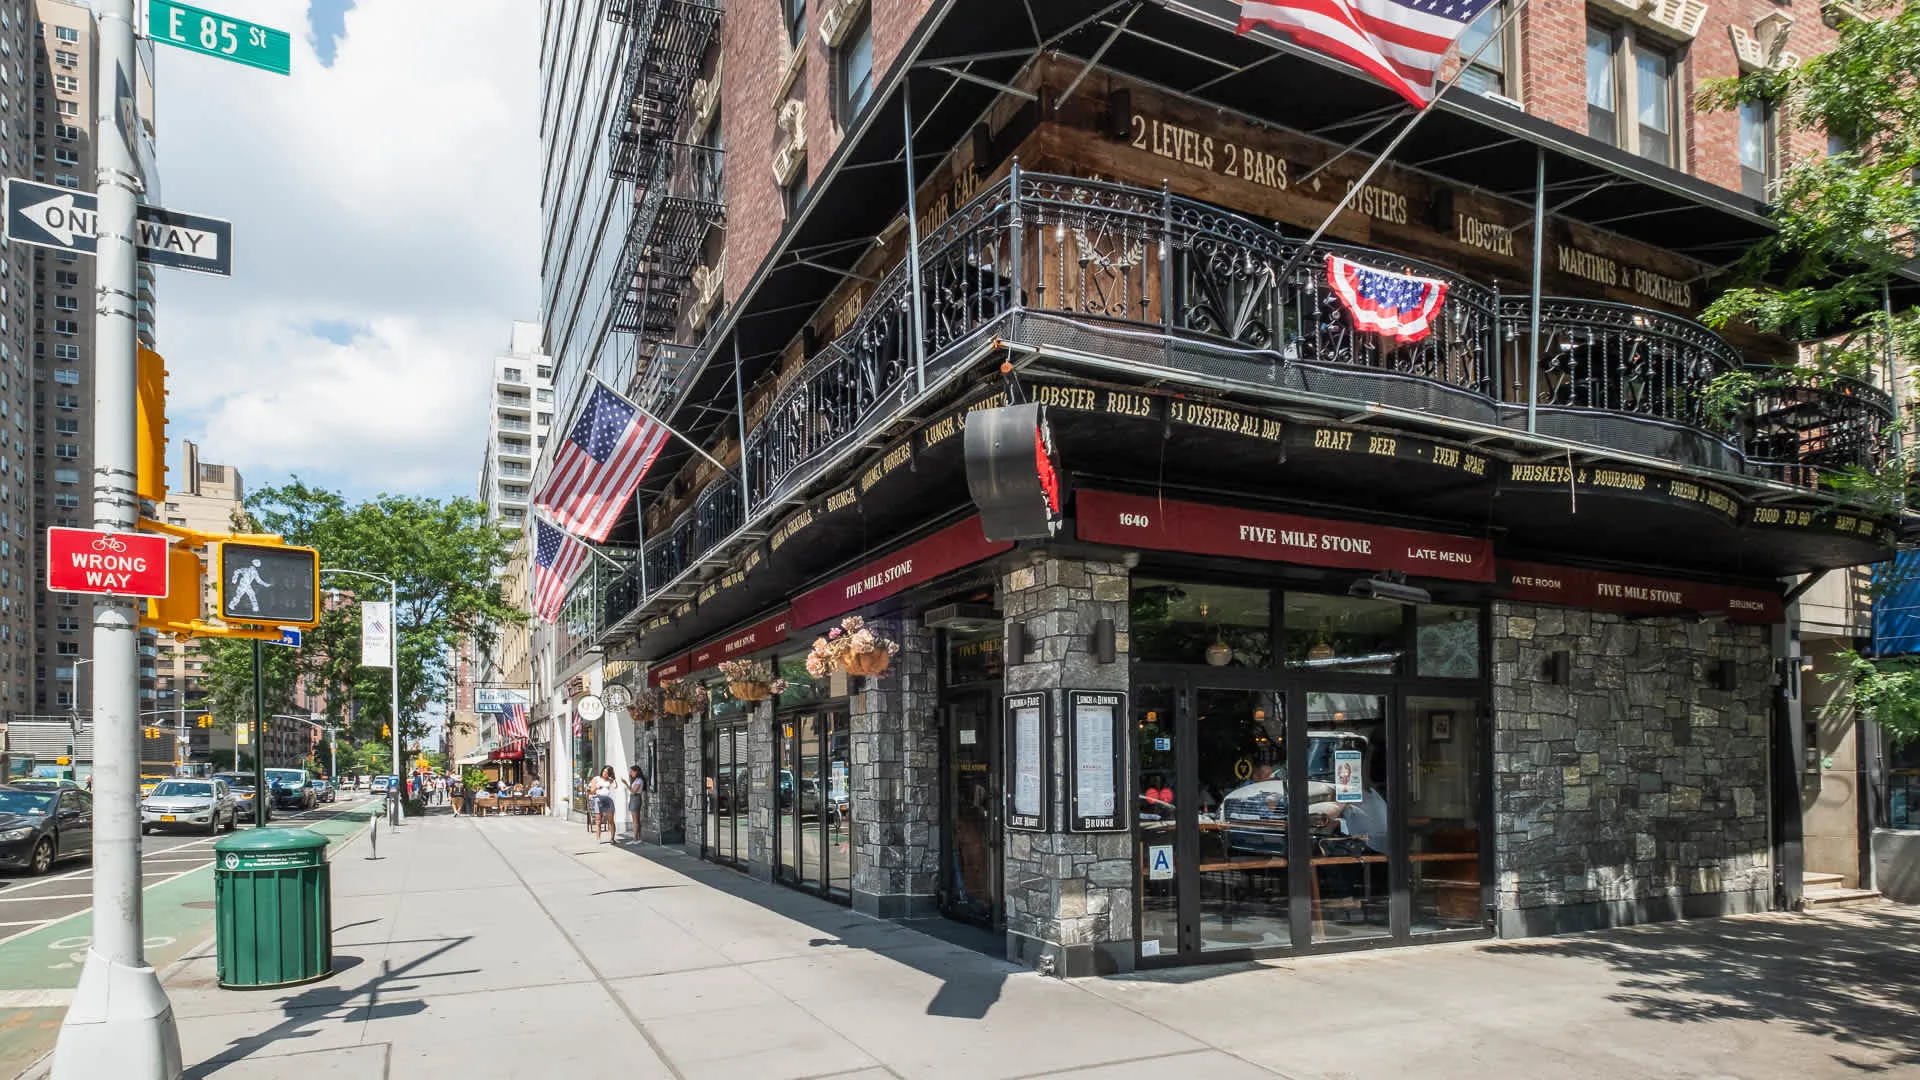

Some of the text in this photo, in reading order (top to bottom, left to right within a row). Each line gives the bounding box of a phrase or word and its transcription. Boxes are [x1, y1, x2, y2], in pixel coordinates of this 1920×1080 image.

[169, 8, 267, 54] E 85 St
[1132, 115, 1288, 191] 2 LEVELS 2 BARS
[1346, 179, 1407, 225] OYSTERS
[140, 222, 204, 253] WAY
[1459, 213, 1514, 257] LOBSTER
[1558, 244, 1691, 309] MARTINIS & COCKTAILS
[1032, 385, 1151, 416] LOBSTER ROLLS
[925, 415, 955, 447] LUNCH
[1171, 402, 1281, 440] $1 OYSTERS ALL DAY
[1314, 430, 1396, 457] CRAFT BEER
[1433, 446, 1460, 468] EVENT
[1511, 465, 1646, 490] WHISKEYS & BOURBONS
[827, 487, 857, 513] BRUNCH
[1119, 512, 1149, 528] 1640
[1753, 507, 1779, 523] FOOD
[1239, 525, 1372, 554] FIVE MILE STONE
[72, 553, 147, 572] WRONG
[1408, 547, 1472, 564] LATE MENU
[86, 571, 132, 588] WAY
[846, 560, 913, 599] FIVE MILE STONE
[1535, 578, 1561, 589] ROOM
[1597, 583, 1682, 605] FIVE MILE STONE
[1729, 599, 1764, 611] BRUNCH
[1085, 818, 1114, 829] BRUNCH
[1154, 850, 1169, 870] A
